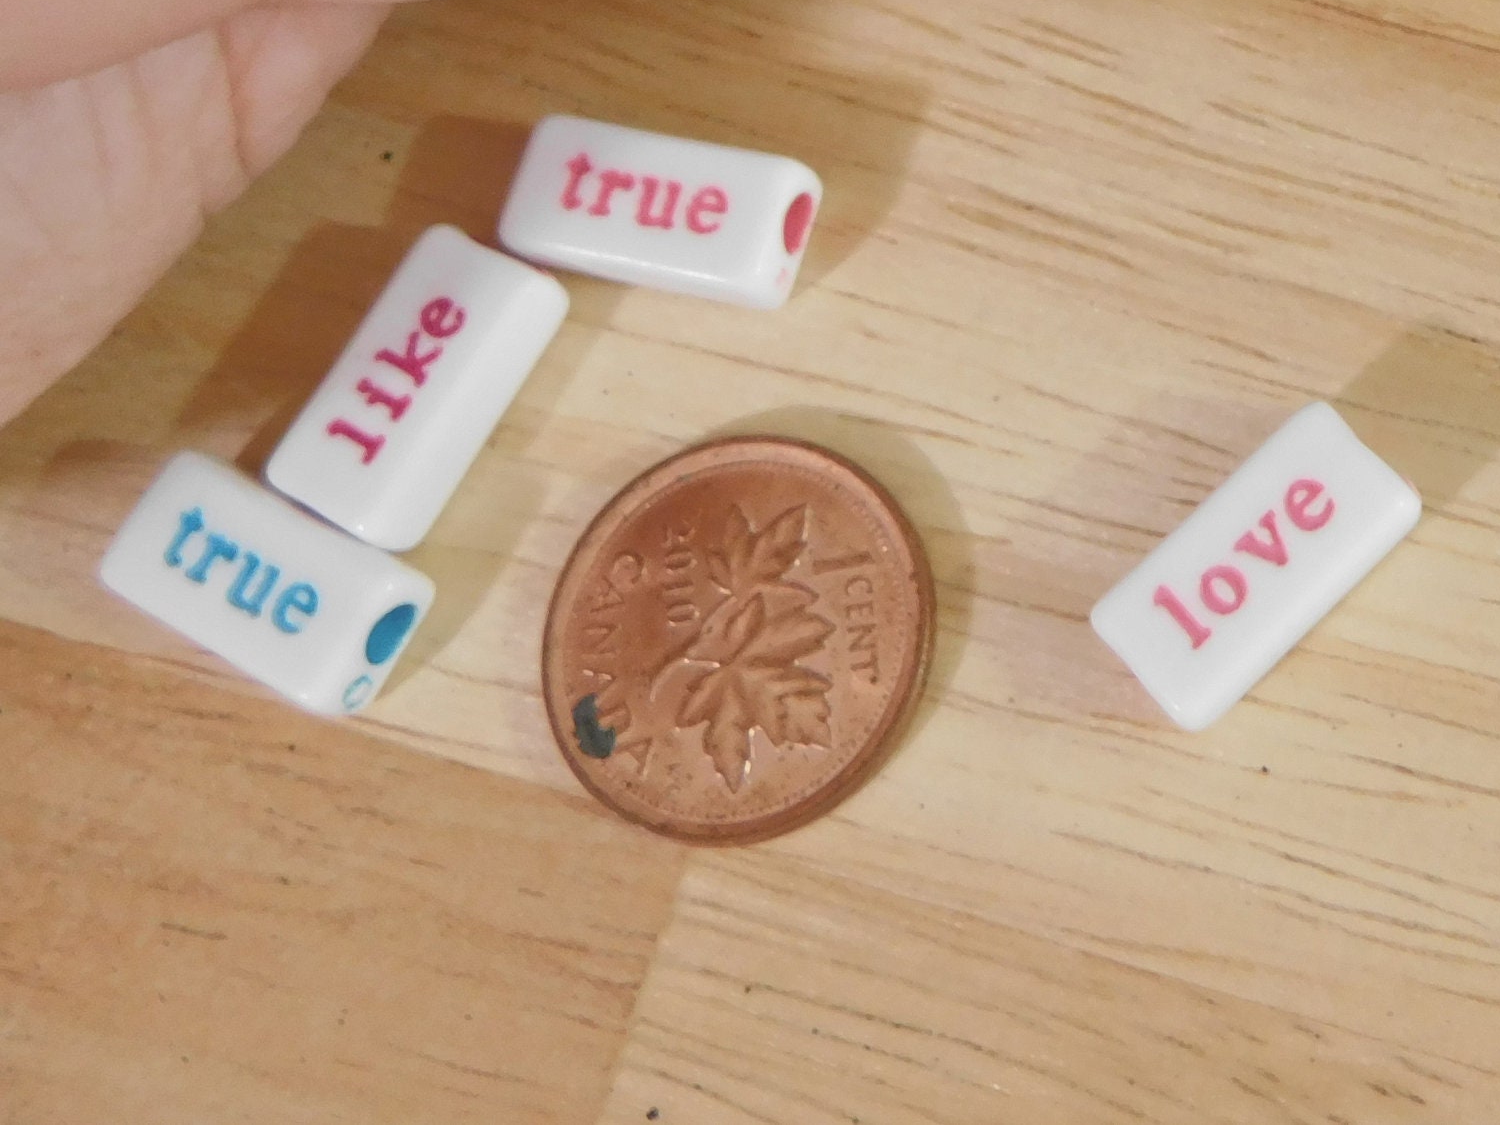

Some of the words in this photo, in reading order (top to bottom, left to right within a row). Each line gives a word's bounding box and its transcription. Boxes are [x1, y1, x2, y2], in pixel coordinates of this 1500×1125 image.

[559, 151, 730, 236] true
[326, 296, 468, 465] like
[162, 506, 321, 635] true
[1151, 477, 1336, 651] love
[843, 578, 880, 683] CENT
